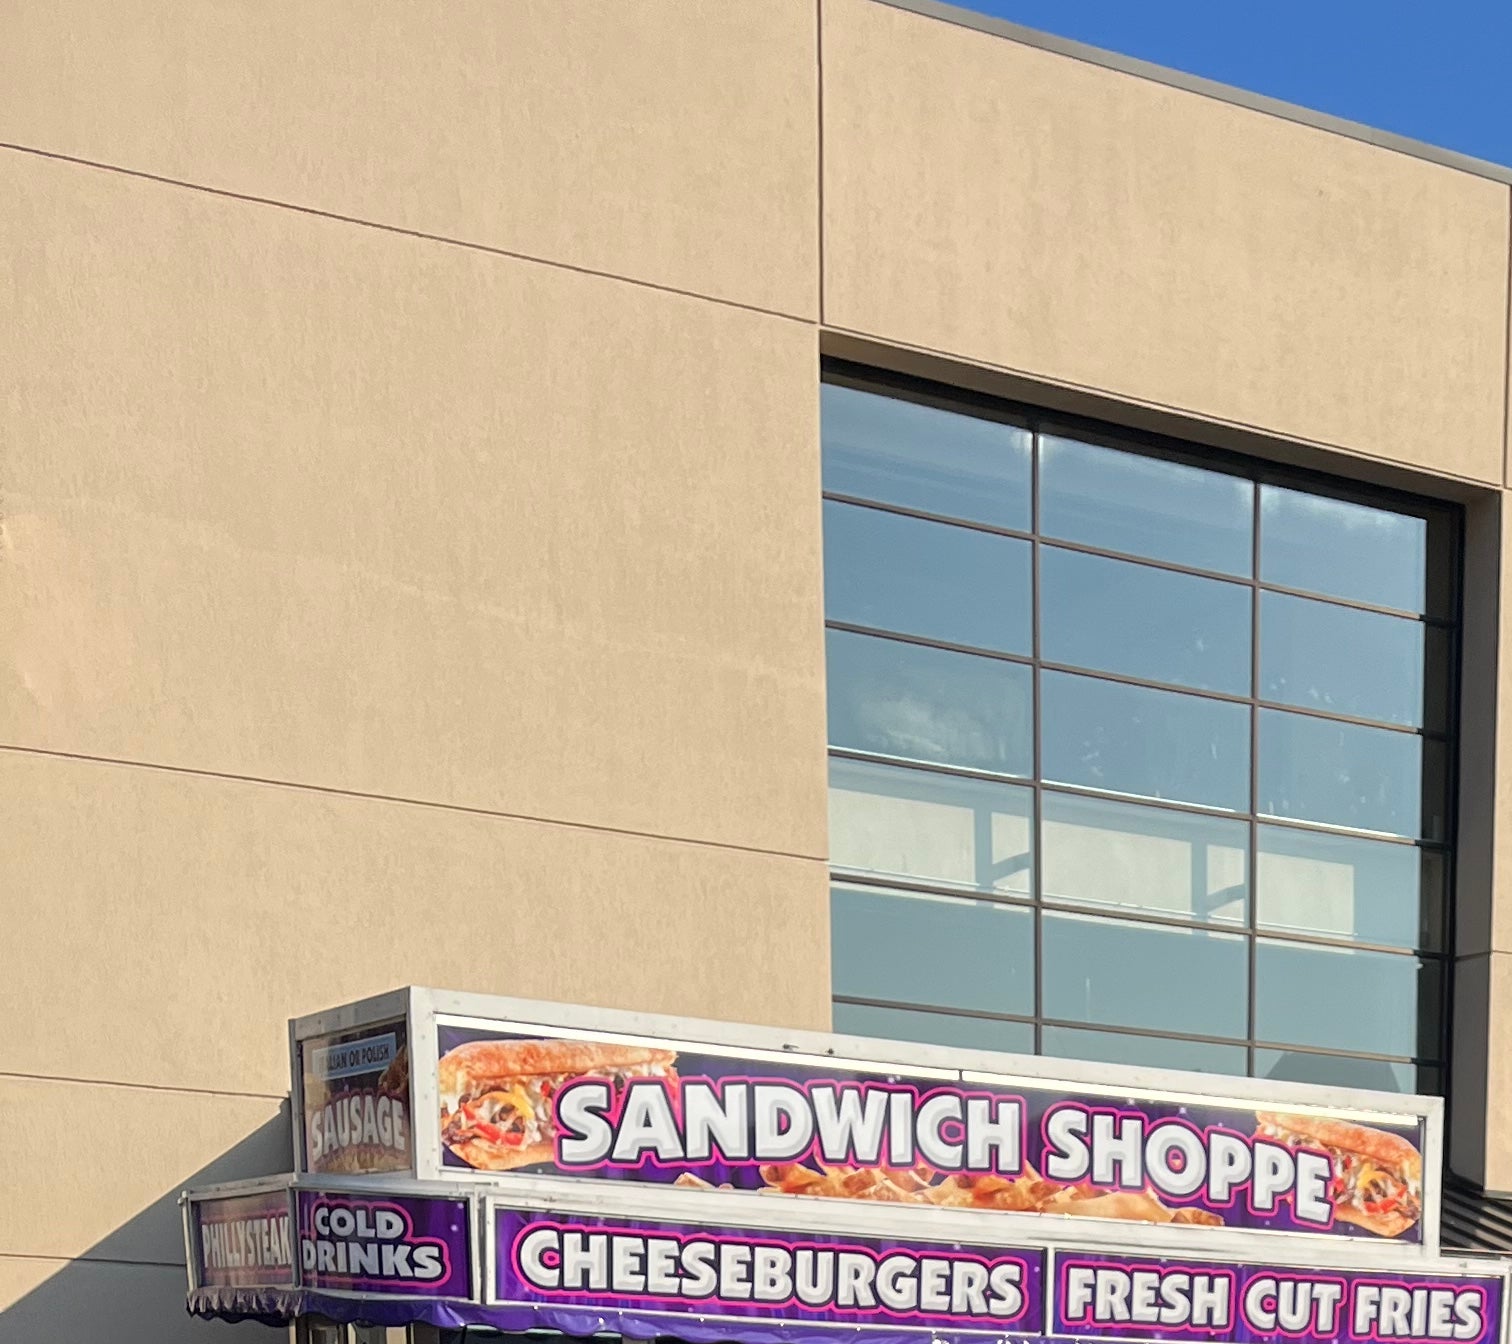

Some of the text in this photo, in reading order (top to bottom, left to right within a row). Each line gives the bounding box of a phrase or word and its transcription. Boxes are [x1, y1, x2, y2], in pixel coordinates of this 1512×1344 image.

[311, 1094, 405, 1160] SAUSAGE
[557, 1082, 1332, 1222] SANDWICH SHOPPE
[315, 1206, 404, 1239] COLD
[302, 1239, 442, 1278] DRINKS
[519, 1229, 1023, 1317] CHEESEBURGERS
[1067, 1266, 1483, 1338] FRESH CUT FRIES
